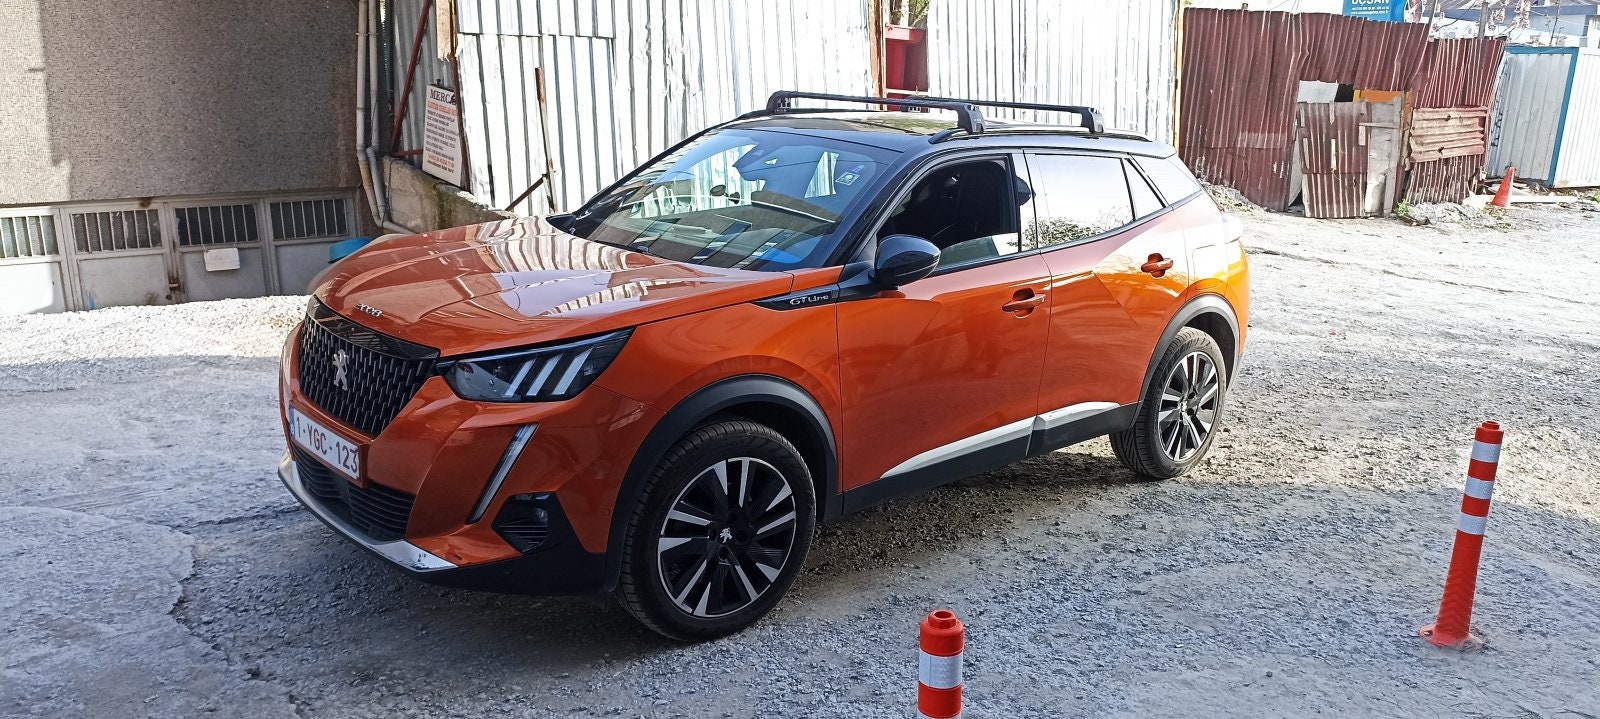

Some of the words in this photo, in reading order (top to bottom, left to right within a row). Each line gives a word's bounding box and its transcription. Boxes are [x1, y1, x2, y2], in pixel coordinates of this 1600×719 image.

[789, 296, 807, 305] GT
[808, 294, 829, 302] Line
[296, 416, 358, 473] 1-YGC-123
